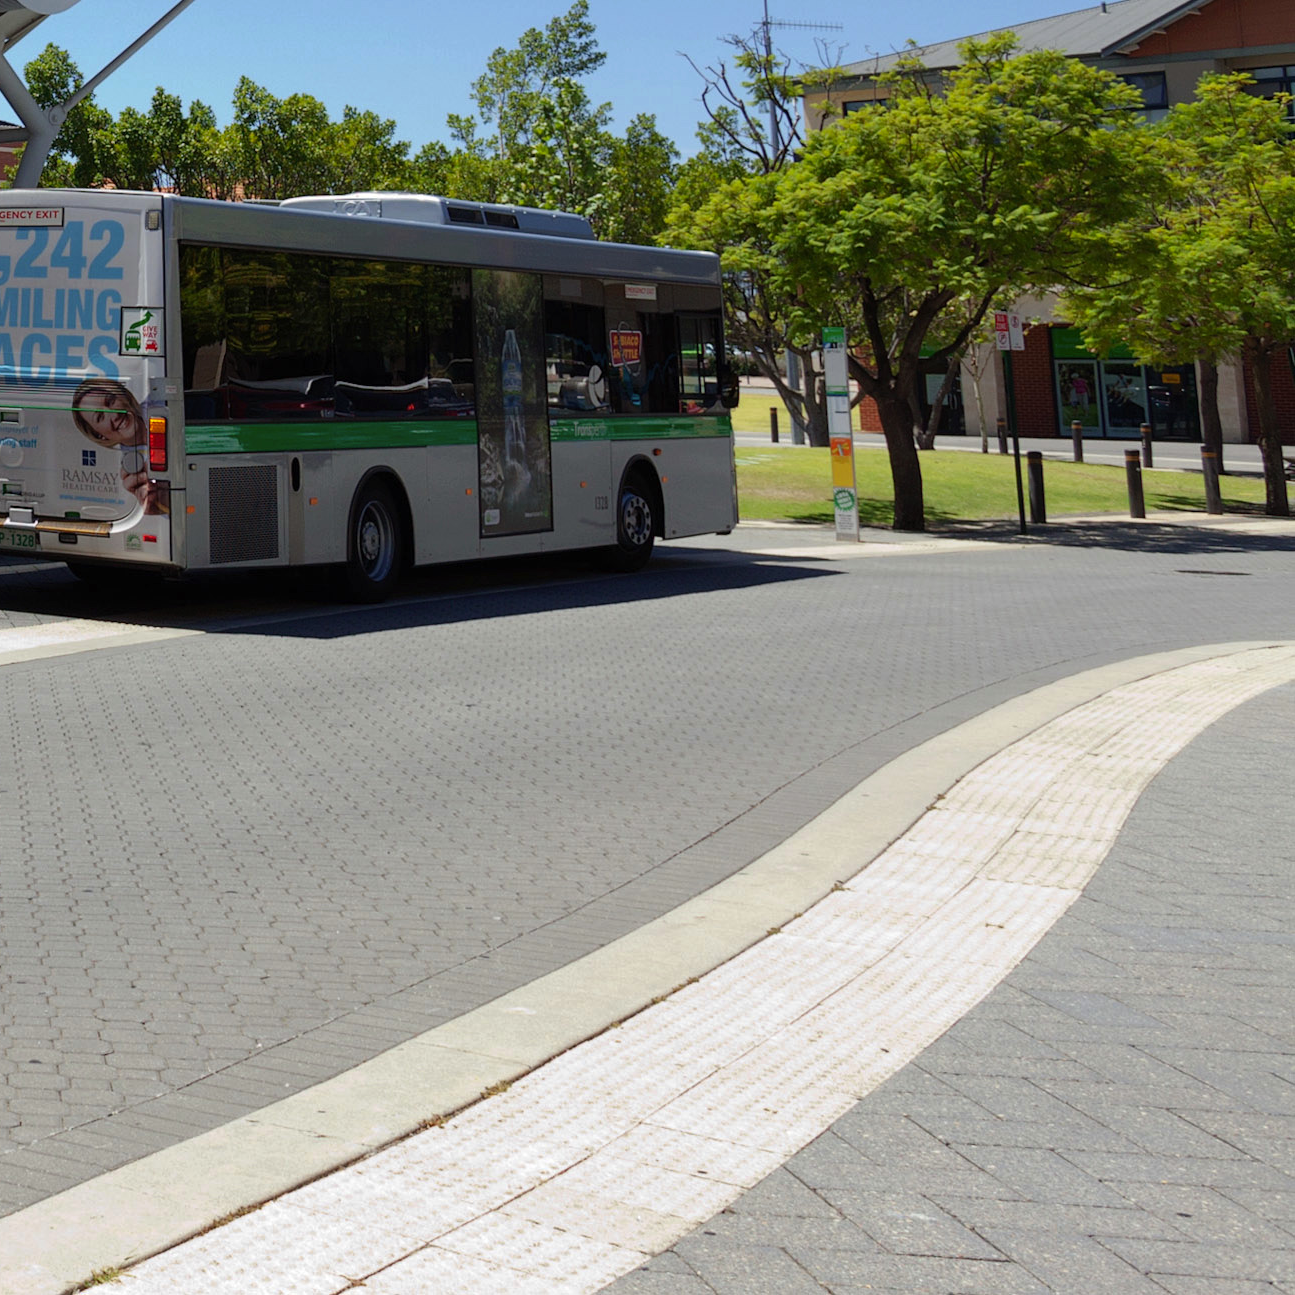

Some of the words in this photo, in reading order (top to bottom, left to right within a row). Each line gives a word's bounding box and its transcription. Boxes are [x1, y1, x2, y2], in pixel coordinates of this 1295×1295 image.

[35, 210, 59, 219] EXIT
[613, 335, 639, 346] SBIACO
[613, 348, 639, 360] SHTTLE
[19, 439, 37, 449] staff
[62, 468, 119, 486] RAMSAY
[62, 482, 96, 492] HEALTH
[97, 485, 119, 494] CARE
